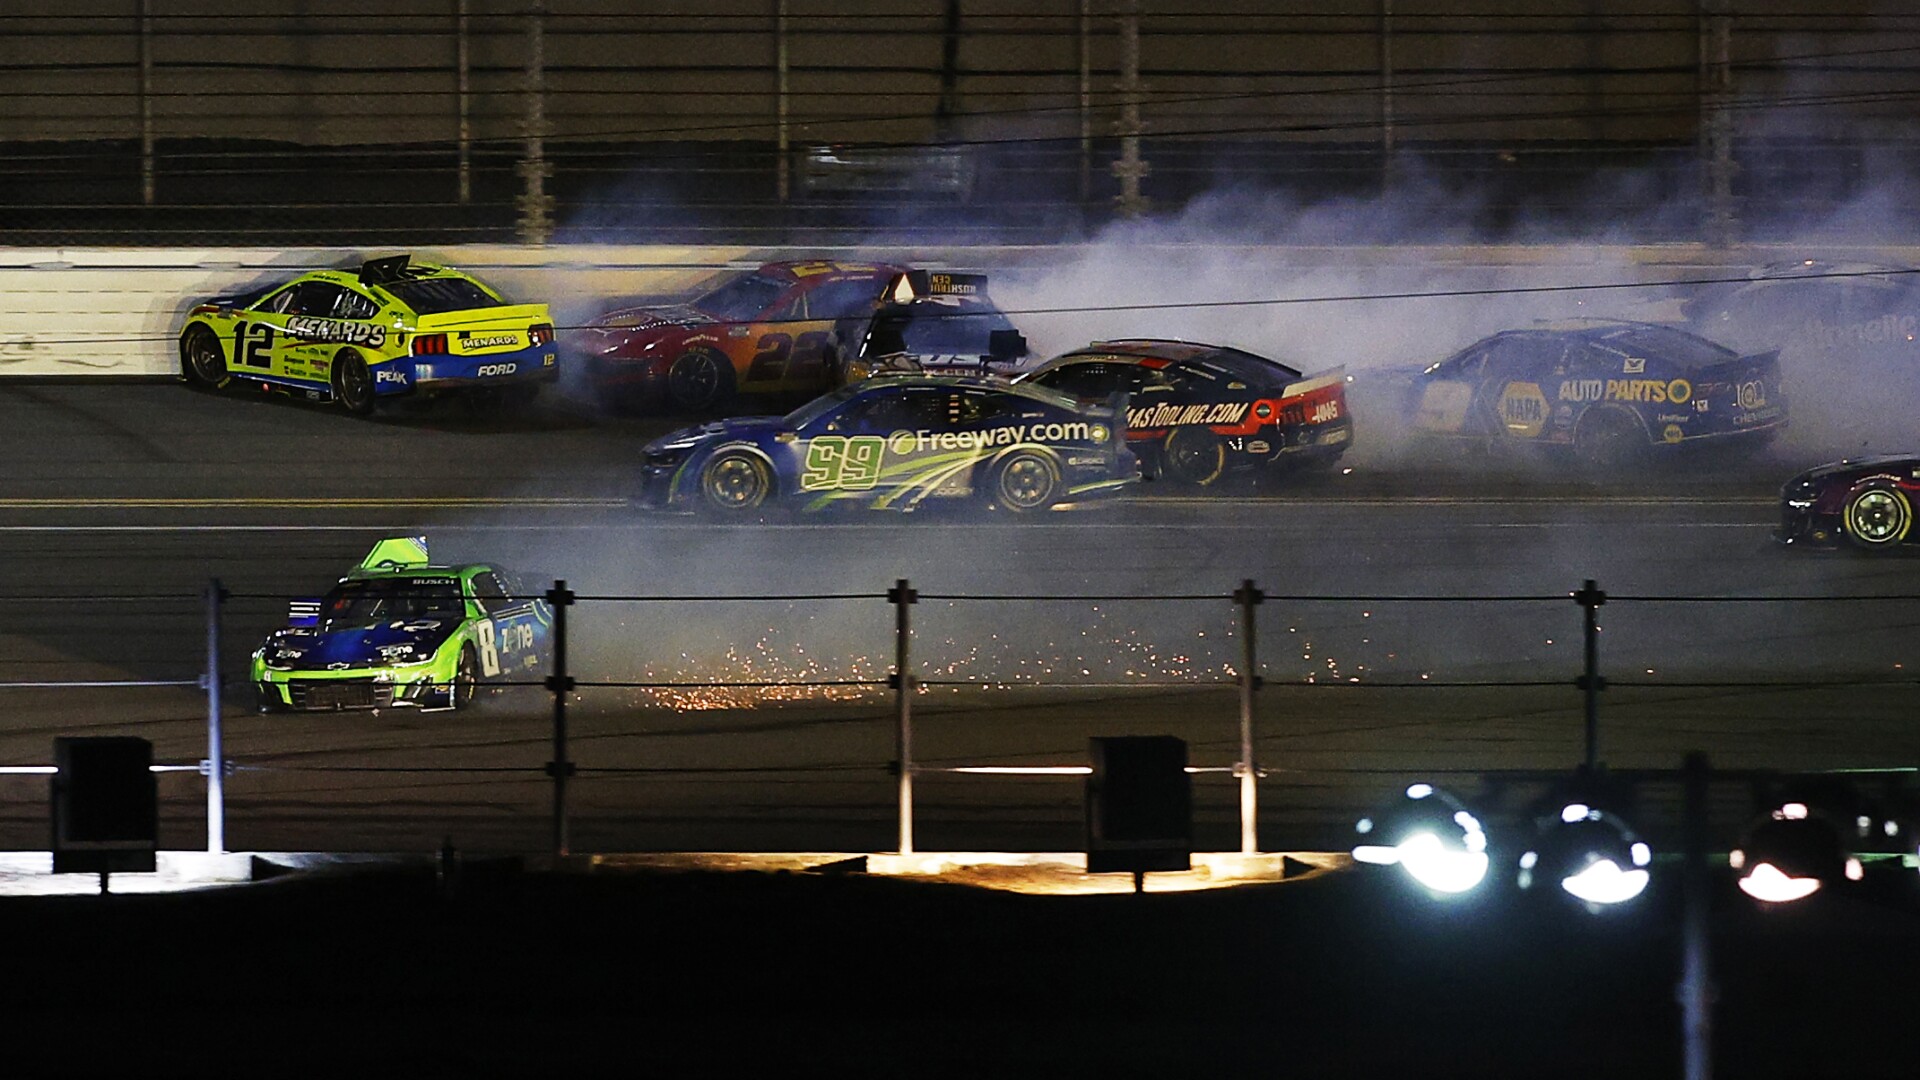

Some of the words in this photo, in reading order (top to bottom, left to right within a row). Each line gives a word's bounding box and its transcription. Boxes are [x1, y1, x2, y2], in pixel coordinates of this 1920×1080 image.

[232, 319, 275, 369] 12
[286, 315, 387, 348] MENARDS
[462, 337, 519, 349] MENARDS
[477, 363, 517, 377] FORD
[543, 354, 555, 366] 12
[376, 371, 408, 385] PEAK
[1559, 380, 1602, 402] AUTO
[1605, 380, 1667, 403] PARTS
[1505, 396, 1541, 421] NAPA
[916, 420, 1090, 452] Freeway.com
[801, 434, 886, 490] 99
[477, 618, 501, 677] 8
